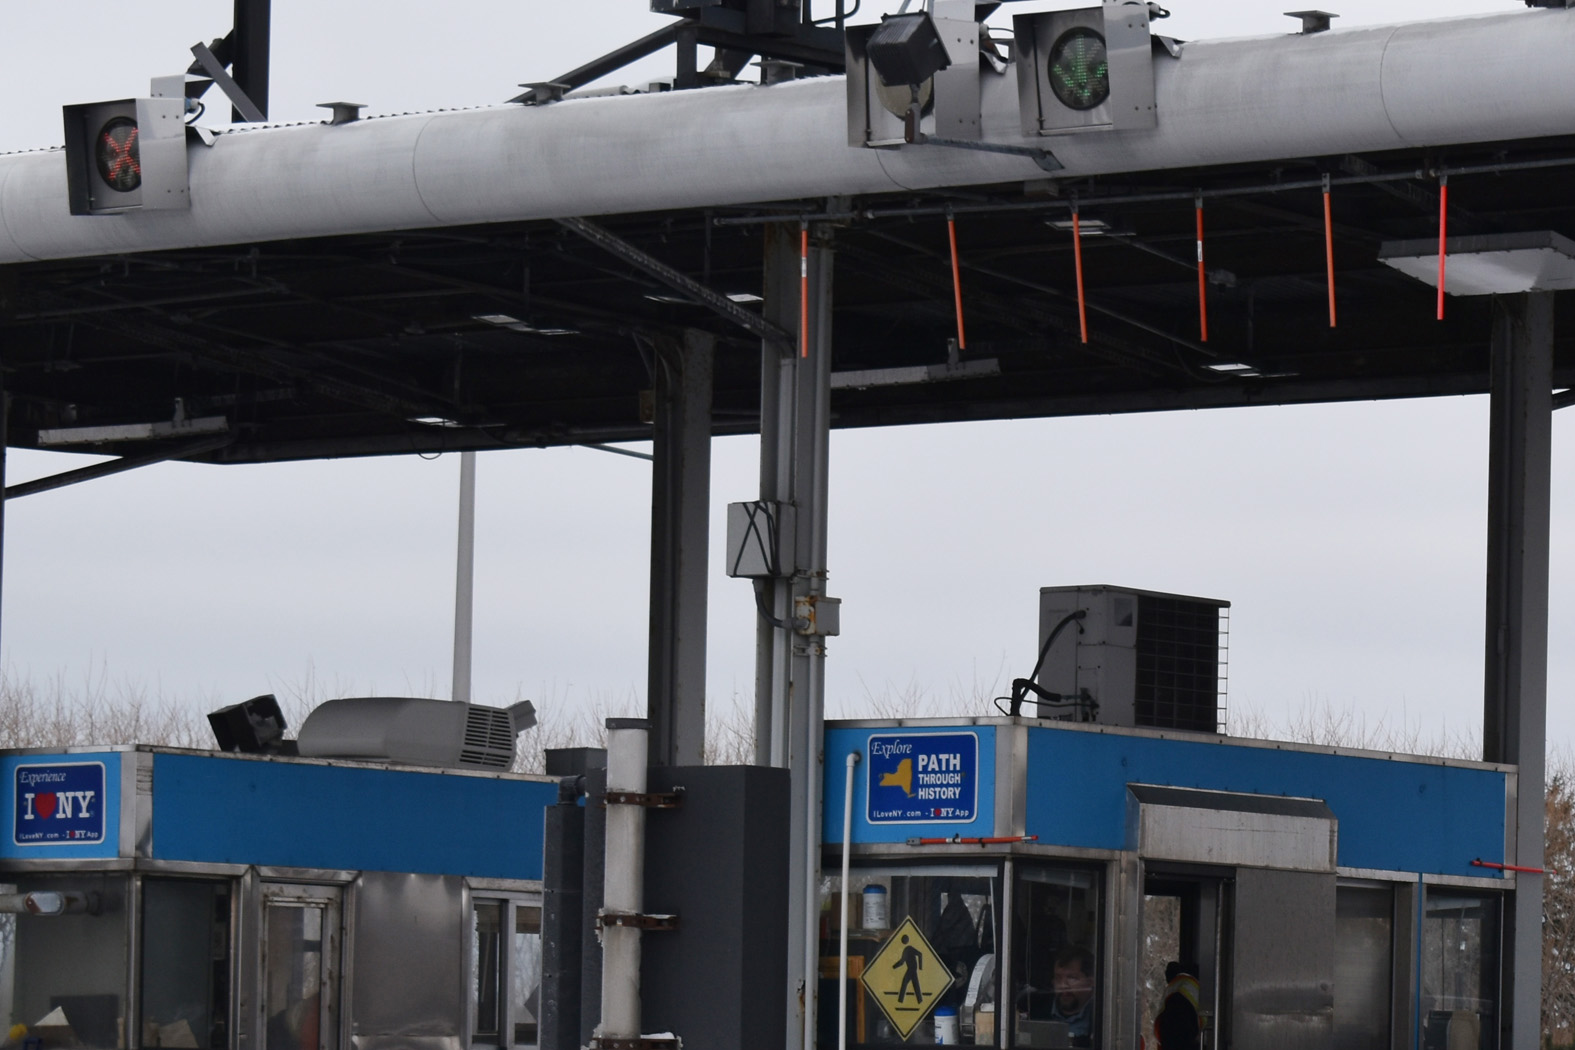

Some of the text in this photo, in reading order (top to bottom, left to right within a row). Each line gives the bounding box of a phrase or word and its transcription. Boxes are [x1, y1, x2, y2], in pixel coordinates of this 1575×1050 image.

[871, 739, 912, 759] Explore
[918, 753, 961, 772] PATH
[20, 770, 66, 787] Experience
[918, 773, 961, 784] THROUGH
[918, 787, 961, 800] HISTORY
[56, 791, 95, 819] NY
[955, 809, 969, 817] App
